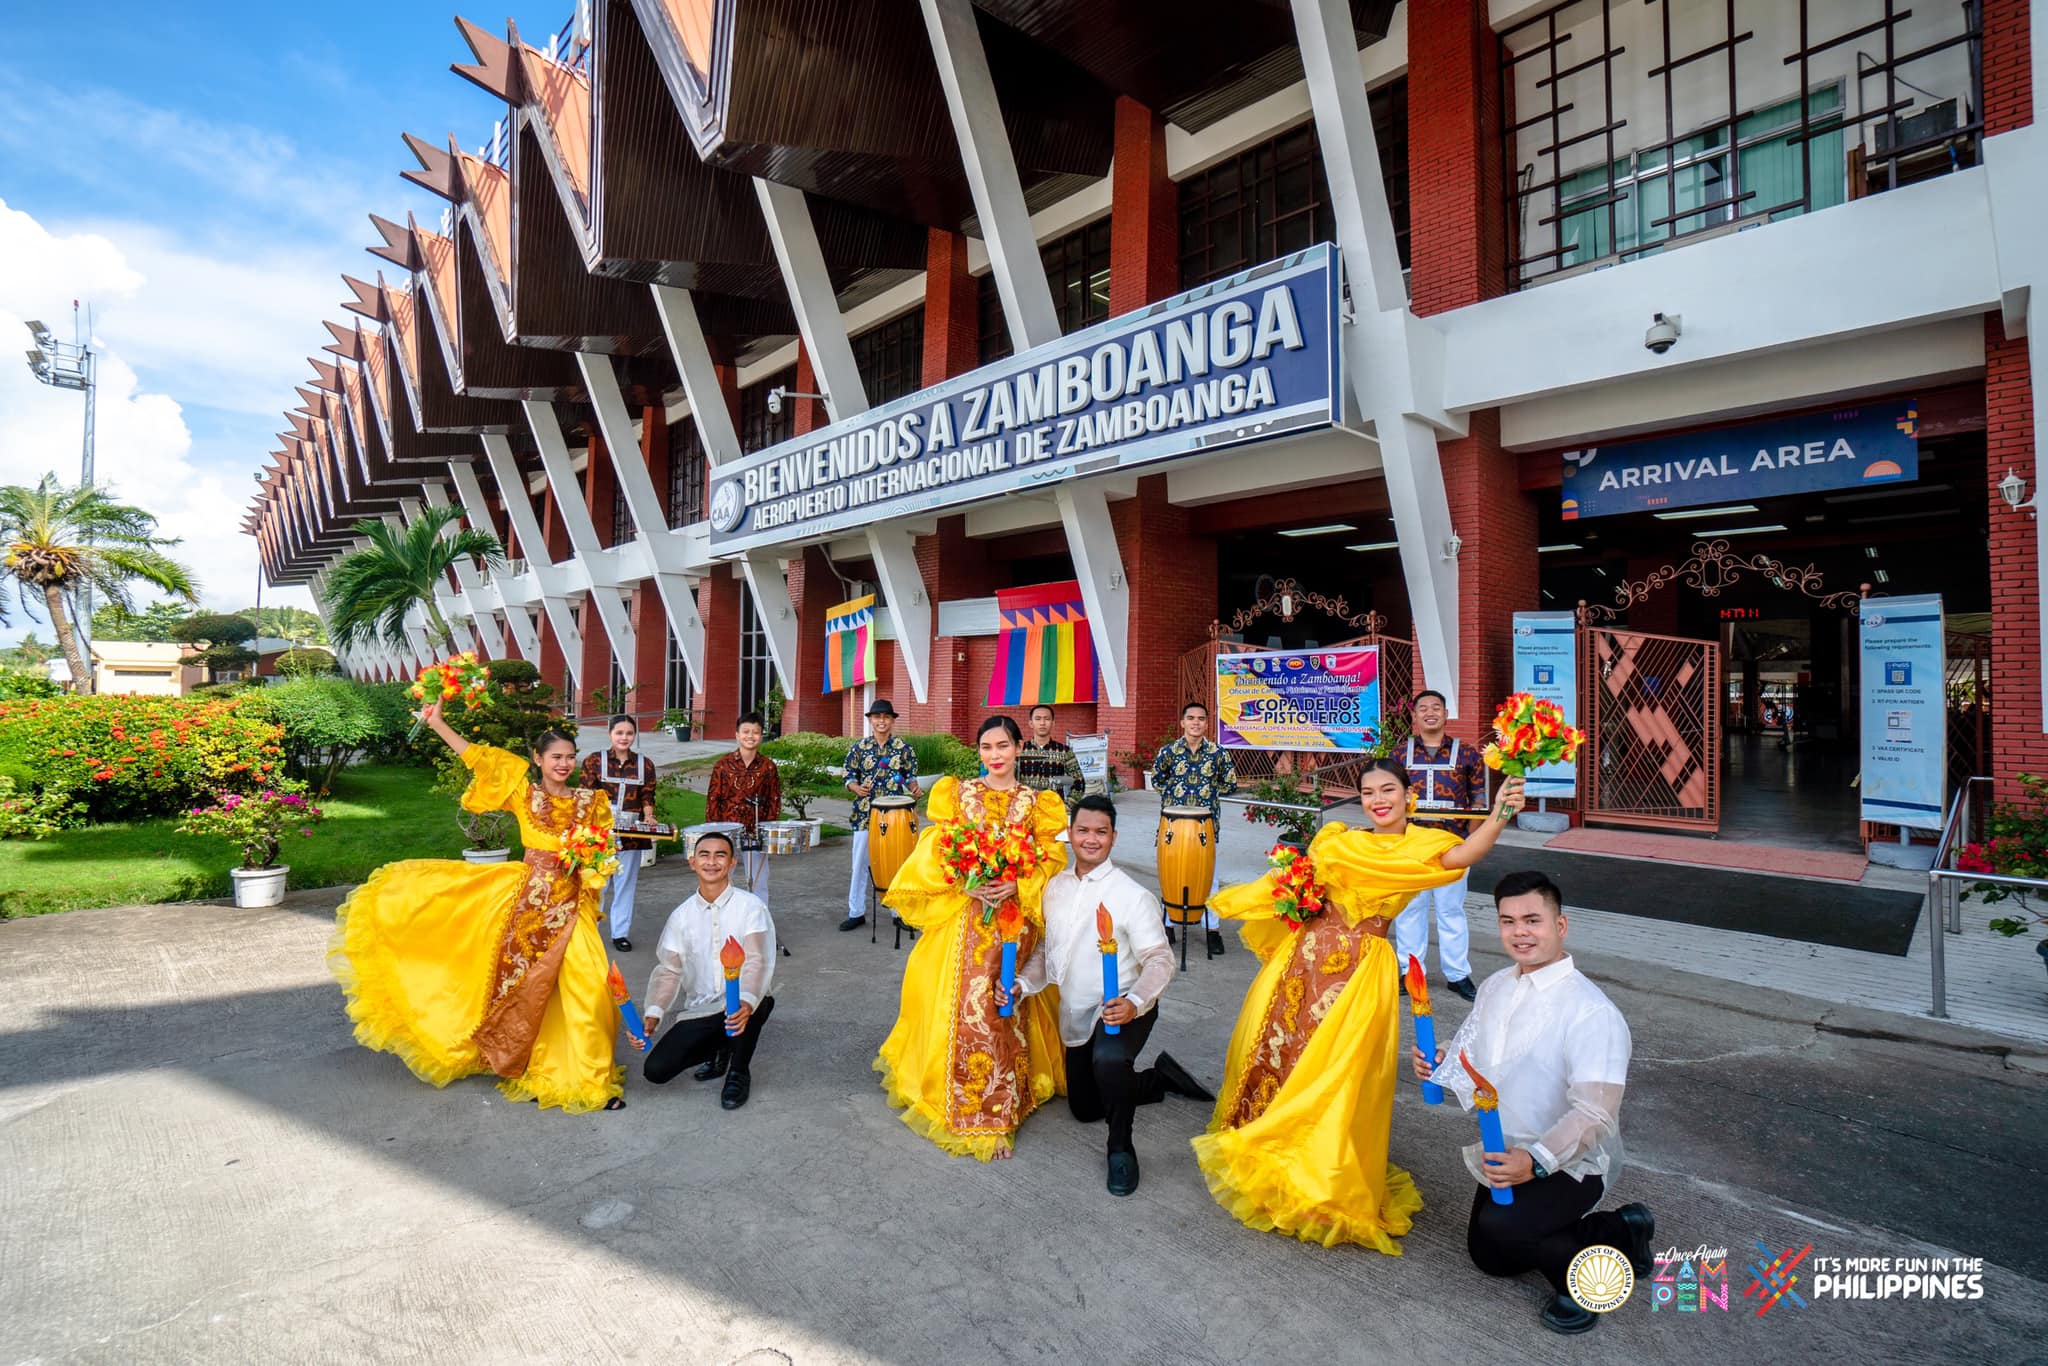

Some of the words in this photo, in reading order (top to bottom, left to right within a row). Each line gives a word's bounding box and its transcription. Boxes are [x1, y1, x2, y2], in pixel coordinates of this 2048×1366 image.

[745, 412, 921, 507] BIENVENIDOS
[927, 401, 956, 452] A
[961, 285, 1304, 441] ZAMBOANGA
[753, 485, 848, 531] AEROPUERTO
[849, 439, 1012, 507] INTERNACIONAL
[1016, 426, 1053, 465] DE
[1057, 366, 1276, 455] ZAMBOANGA
[1599, 454, 1739, 491] ARRIVAL
[1750, 438, 1856, 471] AREA
[712, 507, 730, 521] CAA
[1291, 676, 1297, 684] a
[1300, 670, 1361, 687] Zamboanga!
[1256, 698, 1300, 711] COPA
[1304, 698, 1325, 711] DE
[1329, 697, 1361, 711] LOS
[1264, 711, 1361, 724] PISTOLEROS
